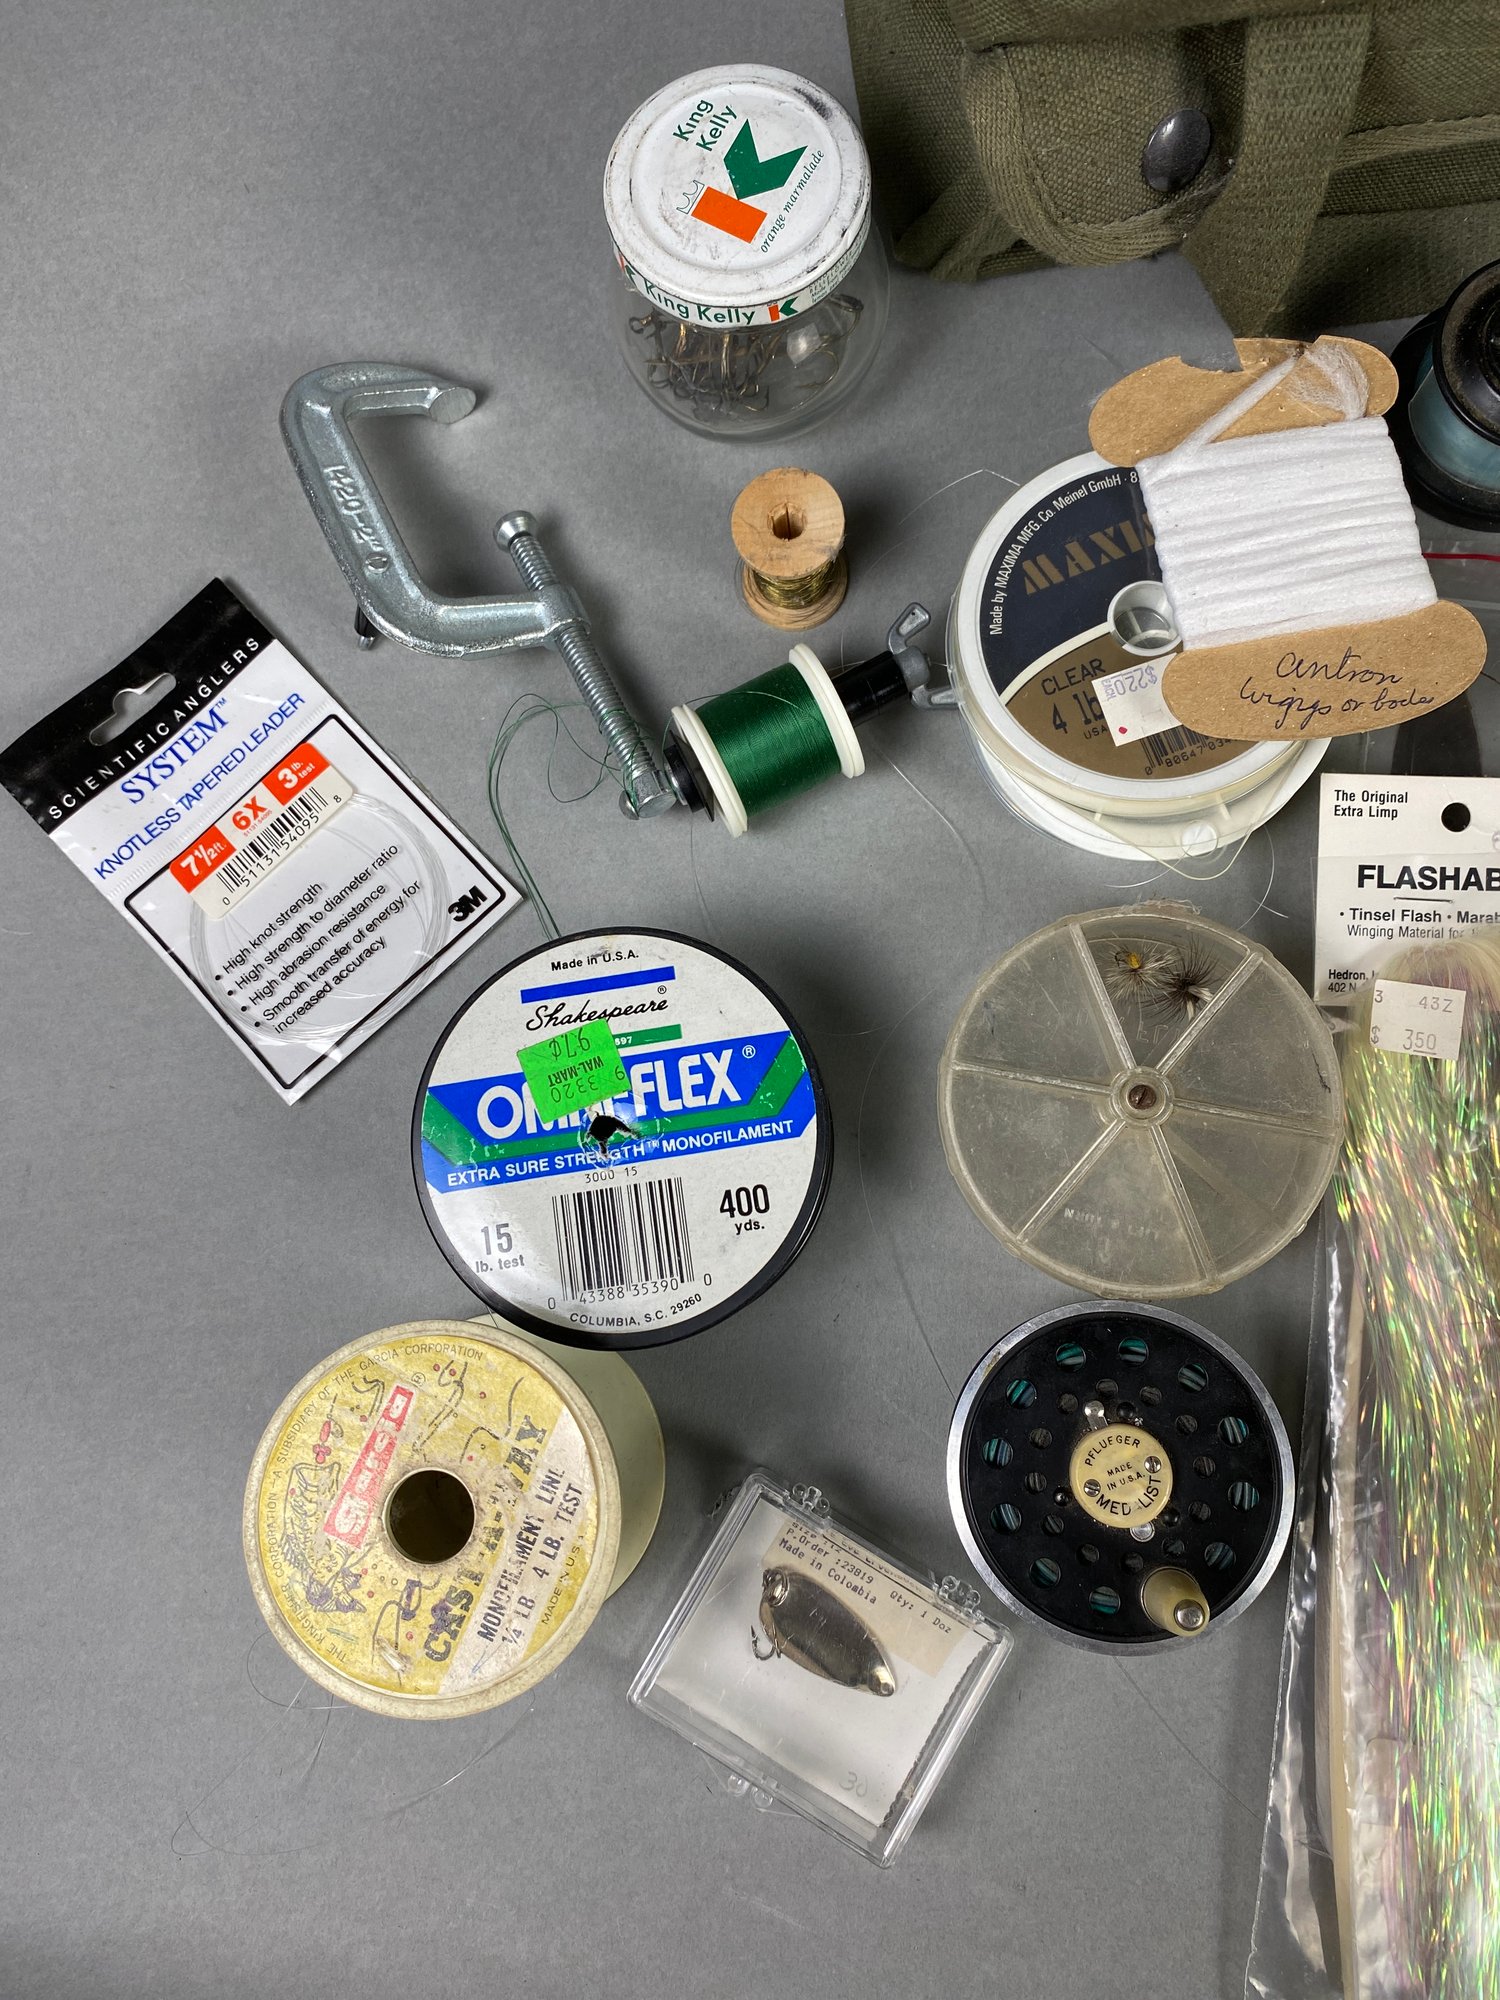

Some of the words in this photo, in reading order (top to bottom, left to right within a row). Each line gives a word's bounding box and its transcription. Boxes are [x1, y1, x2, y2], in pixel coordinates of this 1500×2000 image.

[672, 99, 714, 141] King
[696, 104, 738, 152] Kelly
[760, 213, 786, 253] orange
[783, 150, 825, 213] marmalade
[644, 280, 690, 319] King
[697, 301, 756, 326] Kelly
[1052, 485, 1089, 510] Meinel
[1087, 474, 1122, 494] GmbH
[1037, 509, 1056, 523] Co.
[1017, 520, 1043, 546] MFG.
[994, 543, 1024, 590] MAXIMA
[1022, 513, 1155, 596] MAXI
[991, 591, 1007, 605] by
[990, 606, 1003, 637] Made
[1041, 658, 1107, 697] CLEAR
[1052, 702, 1068, 734] 4
[1341, 697, 1365, 712] or
[49, 723, 170, 820] SCIENTIFIC
[173, 637, 260, 723] ANGLERS
[1083, 723, 1108, 740] USA
[121, 706, 229, 805] SYSTEM
[298, 763, 316, 779] test
[1144, 766, 1153, 776] 0
[1164, 745, 1204, 768] 80647
[94, 807, 182, 880] KNOTLESS
[176, 747, 247, 811] TAPERED
[242, 692, 306, 753] LEADER
[232, 795, 269, 831] 6X
[278, 768, 299, 789] 3
[291, 761, 304, 771] lb.
[1334, 790, 1356, 802] The
[1361, 790, 1408, 804] Original
[1334, 805, 1363, 818] Extra
[1368, 806, 1399, 820] Limp
[223, 896, 231, 906] 0
[240, 848, 281, 887] 51131
[280, 813, 320, 851] 54095
[333, 794, 342, 804] 8
[1357, 864, 1500, 892] FLASHAB
[235, 961, 265, 990] High
[264, 921, 312, 965] strength
[309, 911, 324, 924] to
[324, 867, 372, 913] diameter
[371, 844, 398, 871] ratio
[447, 885, 488, 922] 3M
[1349, 908, 1395, 922] Tinsel
[1401, 909, 1442, 923] Flash
[223, 945, 251, 974] High
[249, 923, 278, 949] knot
[276, 882, 322, 927] strength
[1347, 924, 1394, 940] Winging
[1398, 925, 1444, 940] Material
[249, 977, 280, 1006] High
[279, 935, 329, 981] abrasion
[328, 884, 386, 937] resistance
[263, 980, 309, 1021] Smooth
[307, 941, 352, 982] transfer
[352, 929, 366, 944] of
[365, 897, 406, 933] energy
[402, 880, 421, 902] for
[551, 958, 583, 972] Made
[587, 954, 598, 966] in
[602, 949, 639, 963] U.S.A.
[273, 981, 333, 1034] increased
[332, 935, 387, 985] accuracy
[1328, 969, 1369, 981] Hedron,
[1328, 982, 1347, 993] 402
[1374, 989, 1384, 1004] 3
[526, 999, 669, 1031] Shakespeare
[1402, 1028, 1437, 1051] 350
[548, 1055, 605, 1088] WAL-MART
[551, 1075, 599, 1104] 3320
[447, 1166, 501, 1187] EXTRA
[505, 1159, 550, 1178] SURE
[662, 1119, 793, 1153] MONOFILAMENT
[585, 1169, 615, 1184] 3000
[624, 1166, 638, 1178] 15
[719, 1183, 770, 1218] 400
[481, 1222, 513, 1256] 15
[734, 1219, 765, 1236] yds.
[475, 1260, 494, 1274] lb.
[498, 1254, 525, 1270] test
[547, 1297, 556, 1310] 0
[579, 1287, 625, 1305] 43388
[632, 1277, 679, 1297] 35390
[703, 1273, 712, 1286] 0
[569, 1312, 641, 1328] COLUMBIA,
[644, 1309, 668, 1324] S.C.
[670, 1293, 702, 1316] 29260
[358, 1348, 400, 1371] GARCIA
[405, 1342, 483, 1361] CORPORATION
[332, 1367, 356, 1387] THE
[276, 1403, 319, 1465] SUBSIDIARY
[1085, 1434, 1141, 1467] PFLUEGER
[1106, 1461, 1133, 1477] MADE
[1107, 1481, 1117, 1491] IN
[1119, 1471, 1146, 1486] U.S.A.
[553, 1482, 583, 1524] TEST
[266, 1492, 285, 1578] CORPORATION
[540, 1536, 565, 1562] LB.
[532, 1566, 549, 1580] 4
[779, 1536, 805, 1560] Made
[809, 1556, 822, 1572] in
[827, 1567, 877, 1605] Colombia
[281, 1583, 327, 1645] KINGFISHER
[542, 1587, 562, 1625] MADE
[889, 1590, 914, 1611] Qty:
[932, 1616, 952, 1634] Doz
[326, 1643, 349, 1664] THE
